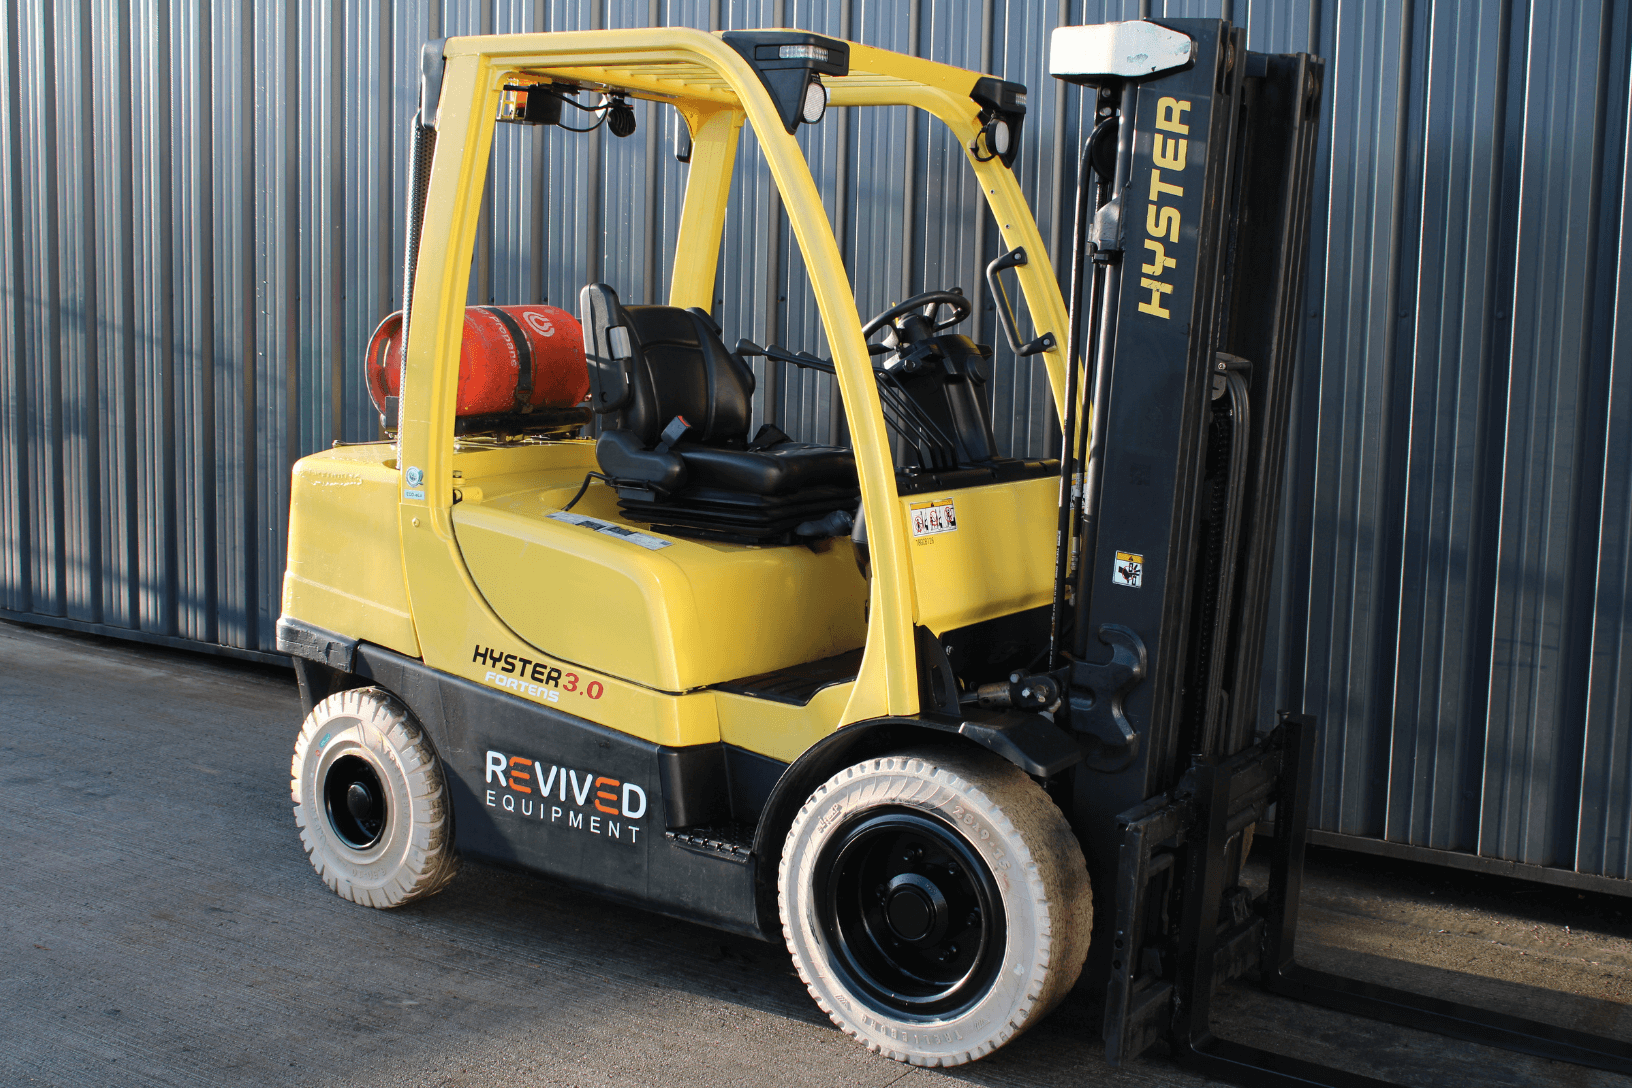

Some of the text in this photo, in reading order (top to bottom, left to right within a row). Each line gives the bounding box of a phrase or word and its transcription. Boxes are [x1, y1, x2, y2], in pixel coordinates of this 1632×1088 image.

[1137, 96, 1191, 320] HYSTER
[472, 644, 604, 700] HYSTER 3.0
[484, 671, 560, 703] FORTENS
[485, 750, 647, 819] REVIVED
[486, 789, 640, 843] EQUIPMENT
